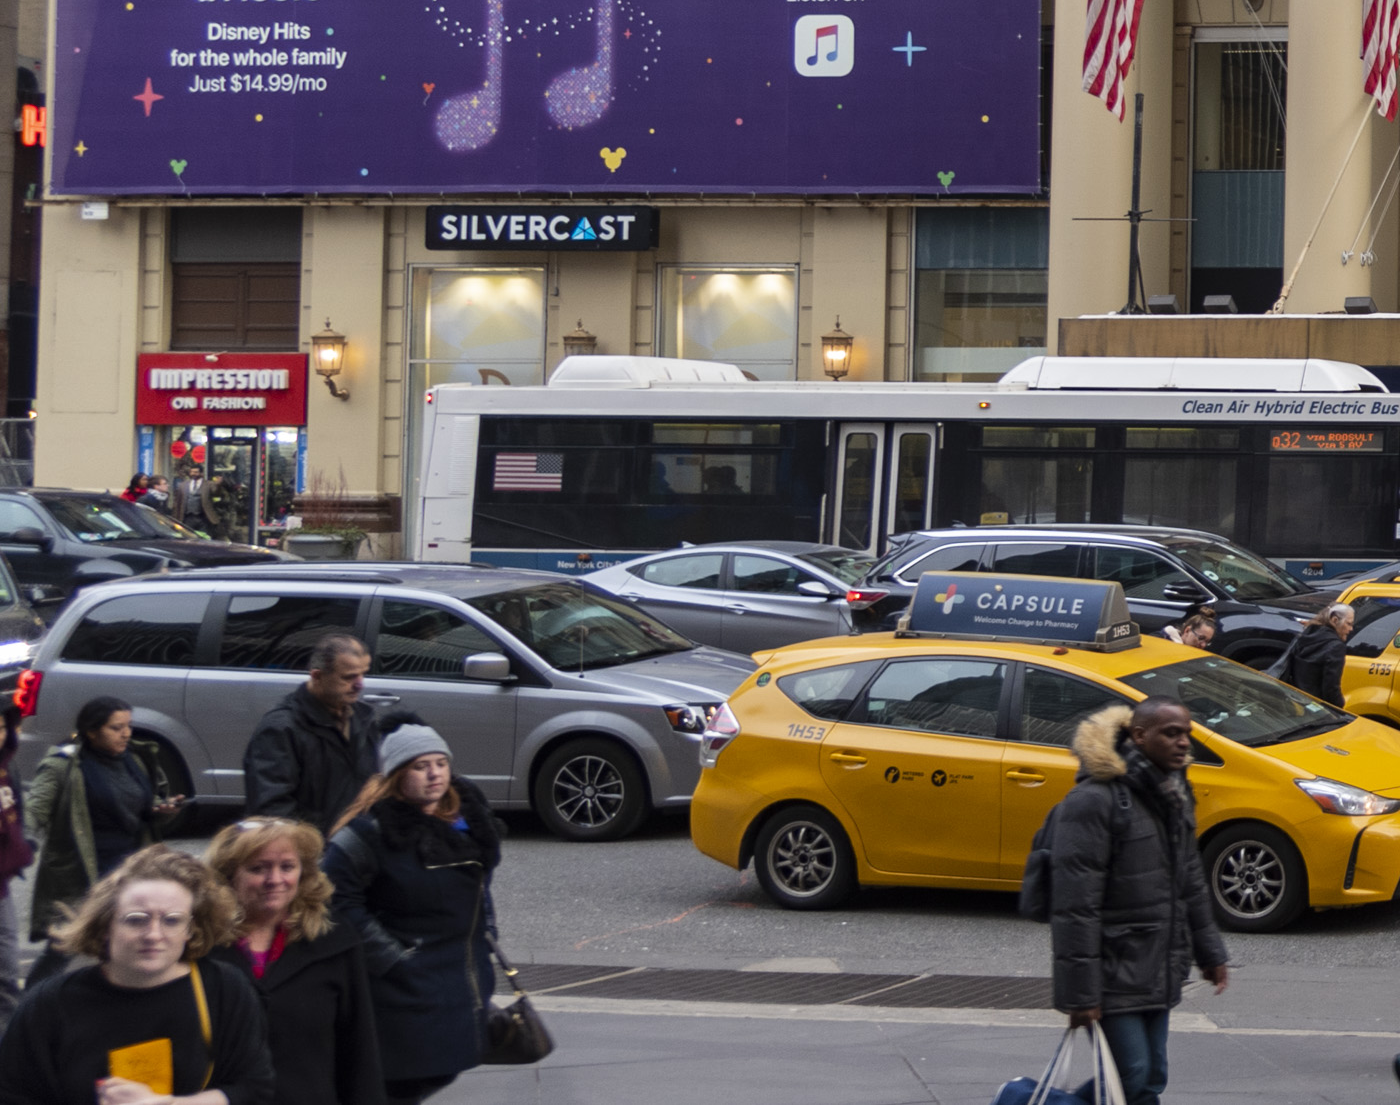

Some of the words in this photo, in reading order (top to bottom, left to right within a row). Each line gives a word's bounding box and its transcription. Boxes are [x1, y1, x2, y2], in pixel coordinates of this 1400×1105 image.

[207, 22, 270, 44] Disney
[274, 22, 311, 40] Hits
[170, 49, 196, 67] for
[199, 48, 230, 66] the
[233, 48, 289, 66] whole
[291, 47, 347, 70] family
[189, 75, 226, 93] Just
[230, 73, 327, 94] $14.99/mo
[150, 368, 289, 390] IMPRESSION
[171, 396, 198, 410] ON
[203, 396, 266, 410] FASHION
[1182, 400, 1224, 414] Clean
[1227, 400, 1250, 414] Air
[1253, 400, 1304, 417] Hybrid
[1308, 400, 1368, 415] Electric
[1370, 401, 1399, 415] Bus
[1328, 433, 1374, 441] ROOSVLT
[1349, 441, 1364, 449] AV
[557, 560, 576, 568] New
[577, 561, 595, 569] York
[1302, 567, 1324, 577] 4204
[977, 593, 1084, 615] CAPSULE
[974, 615, 1007, 626] Welcome
[1008, 617, 1035, 628] Change
[1036, 619, 1043, 627] to
[1044, 619, 1079, 630] Pharmacy
[1112, 624, 1130, 637] 1H53
[1368, 663, 1391, 676] 2T35
[788, 723, 825, 740] 1H53
